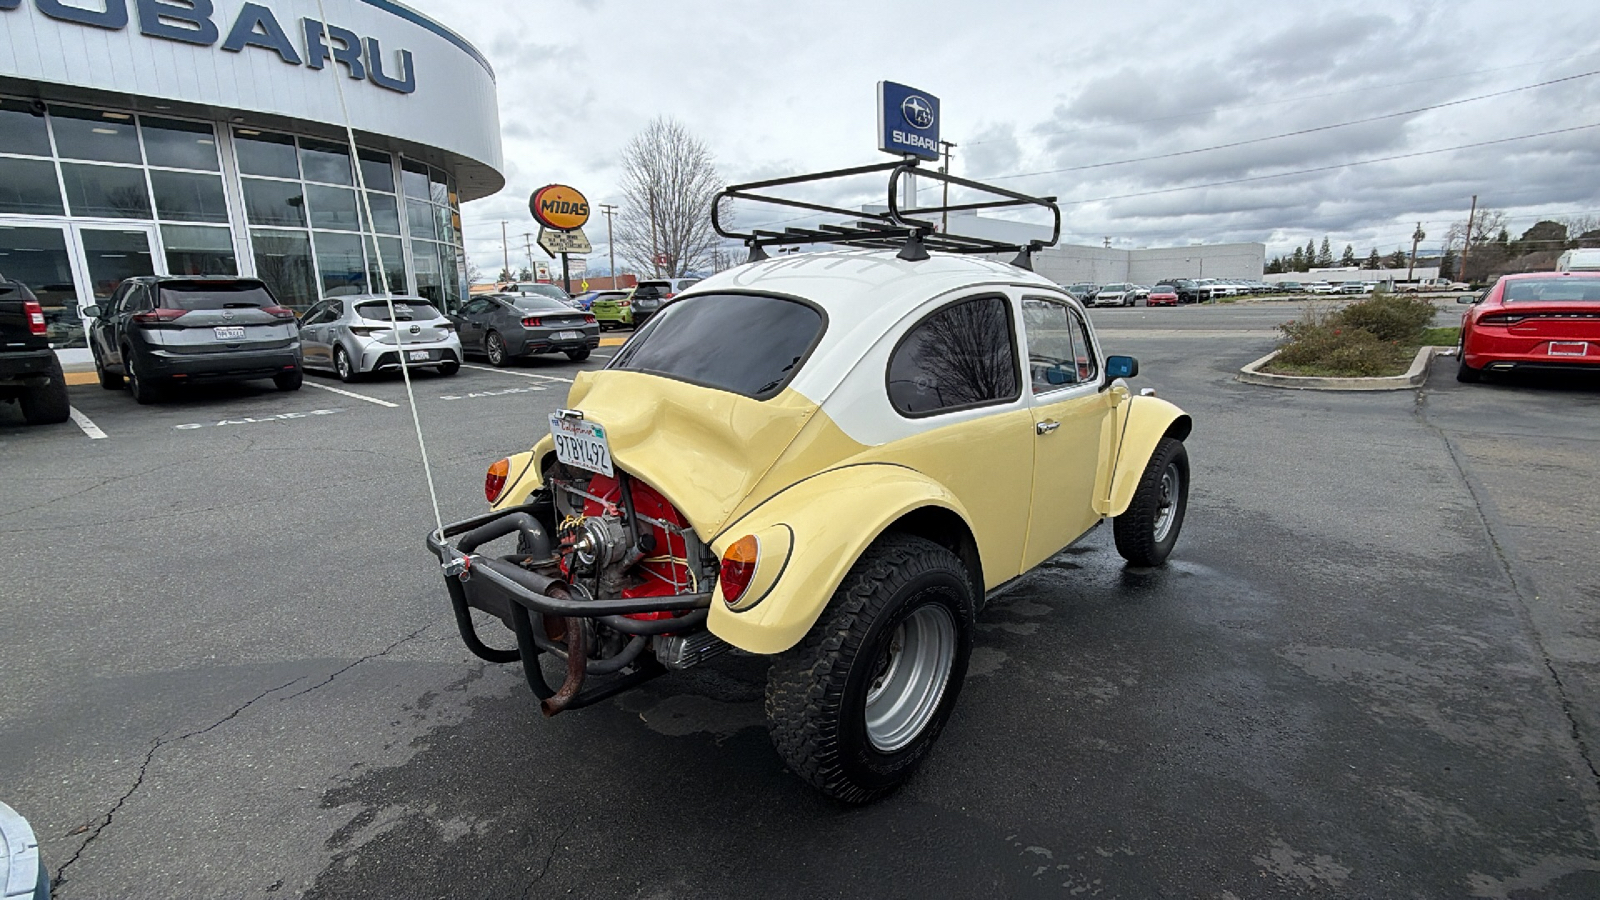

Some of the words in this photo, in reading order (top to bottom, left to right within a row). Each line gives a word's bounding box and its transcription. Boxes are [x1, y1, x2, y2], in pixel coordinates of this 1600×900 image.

[892, 130, 938, 152] SUBARU
[541, 199, 588, 216] MIDAS
[556, 434, 609, 470] 9TBY492
